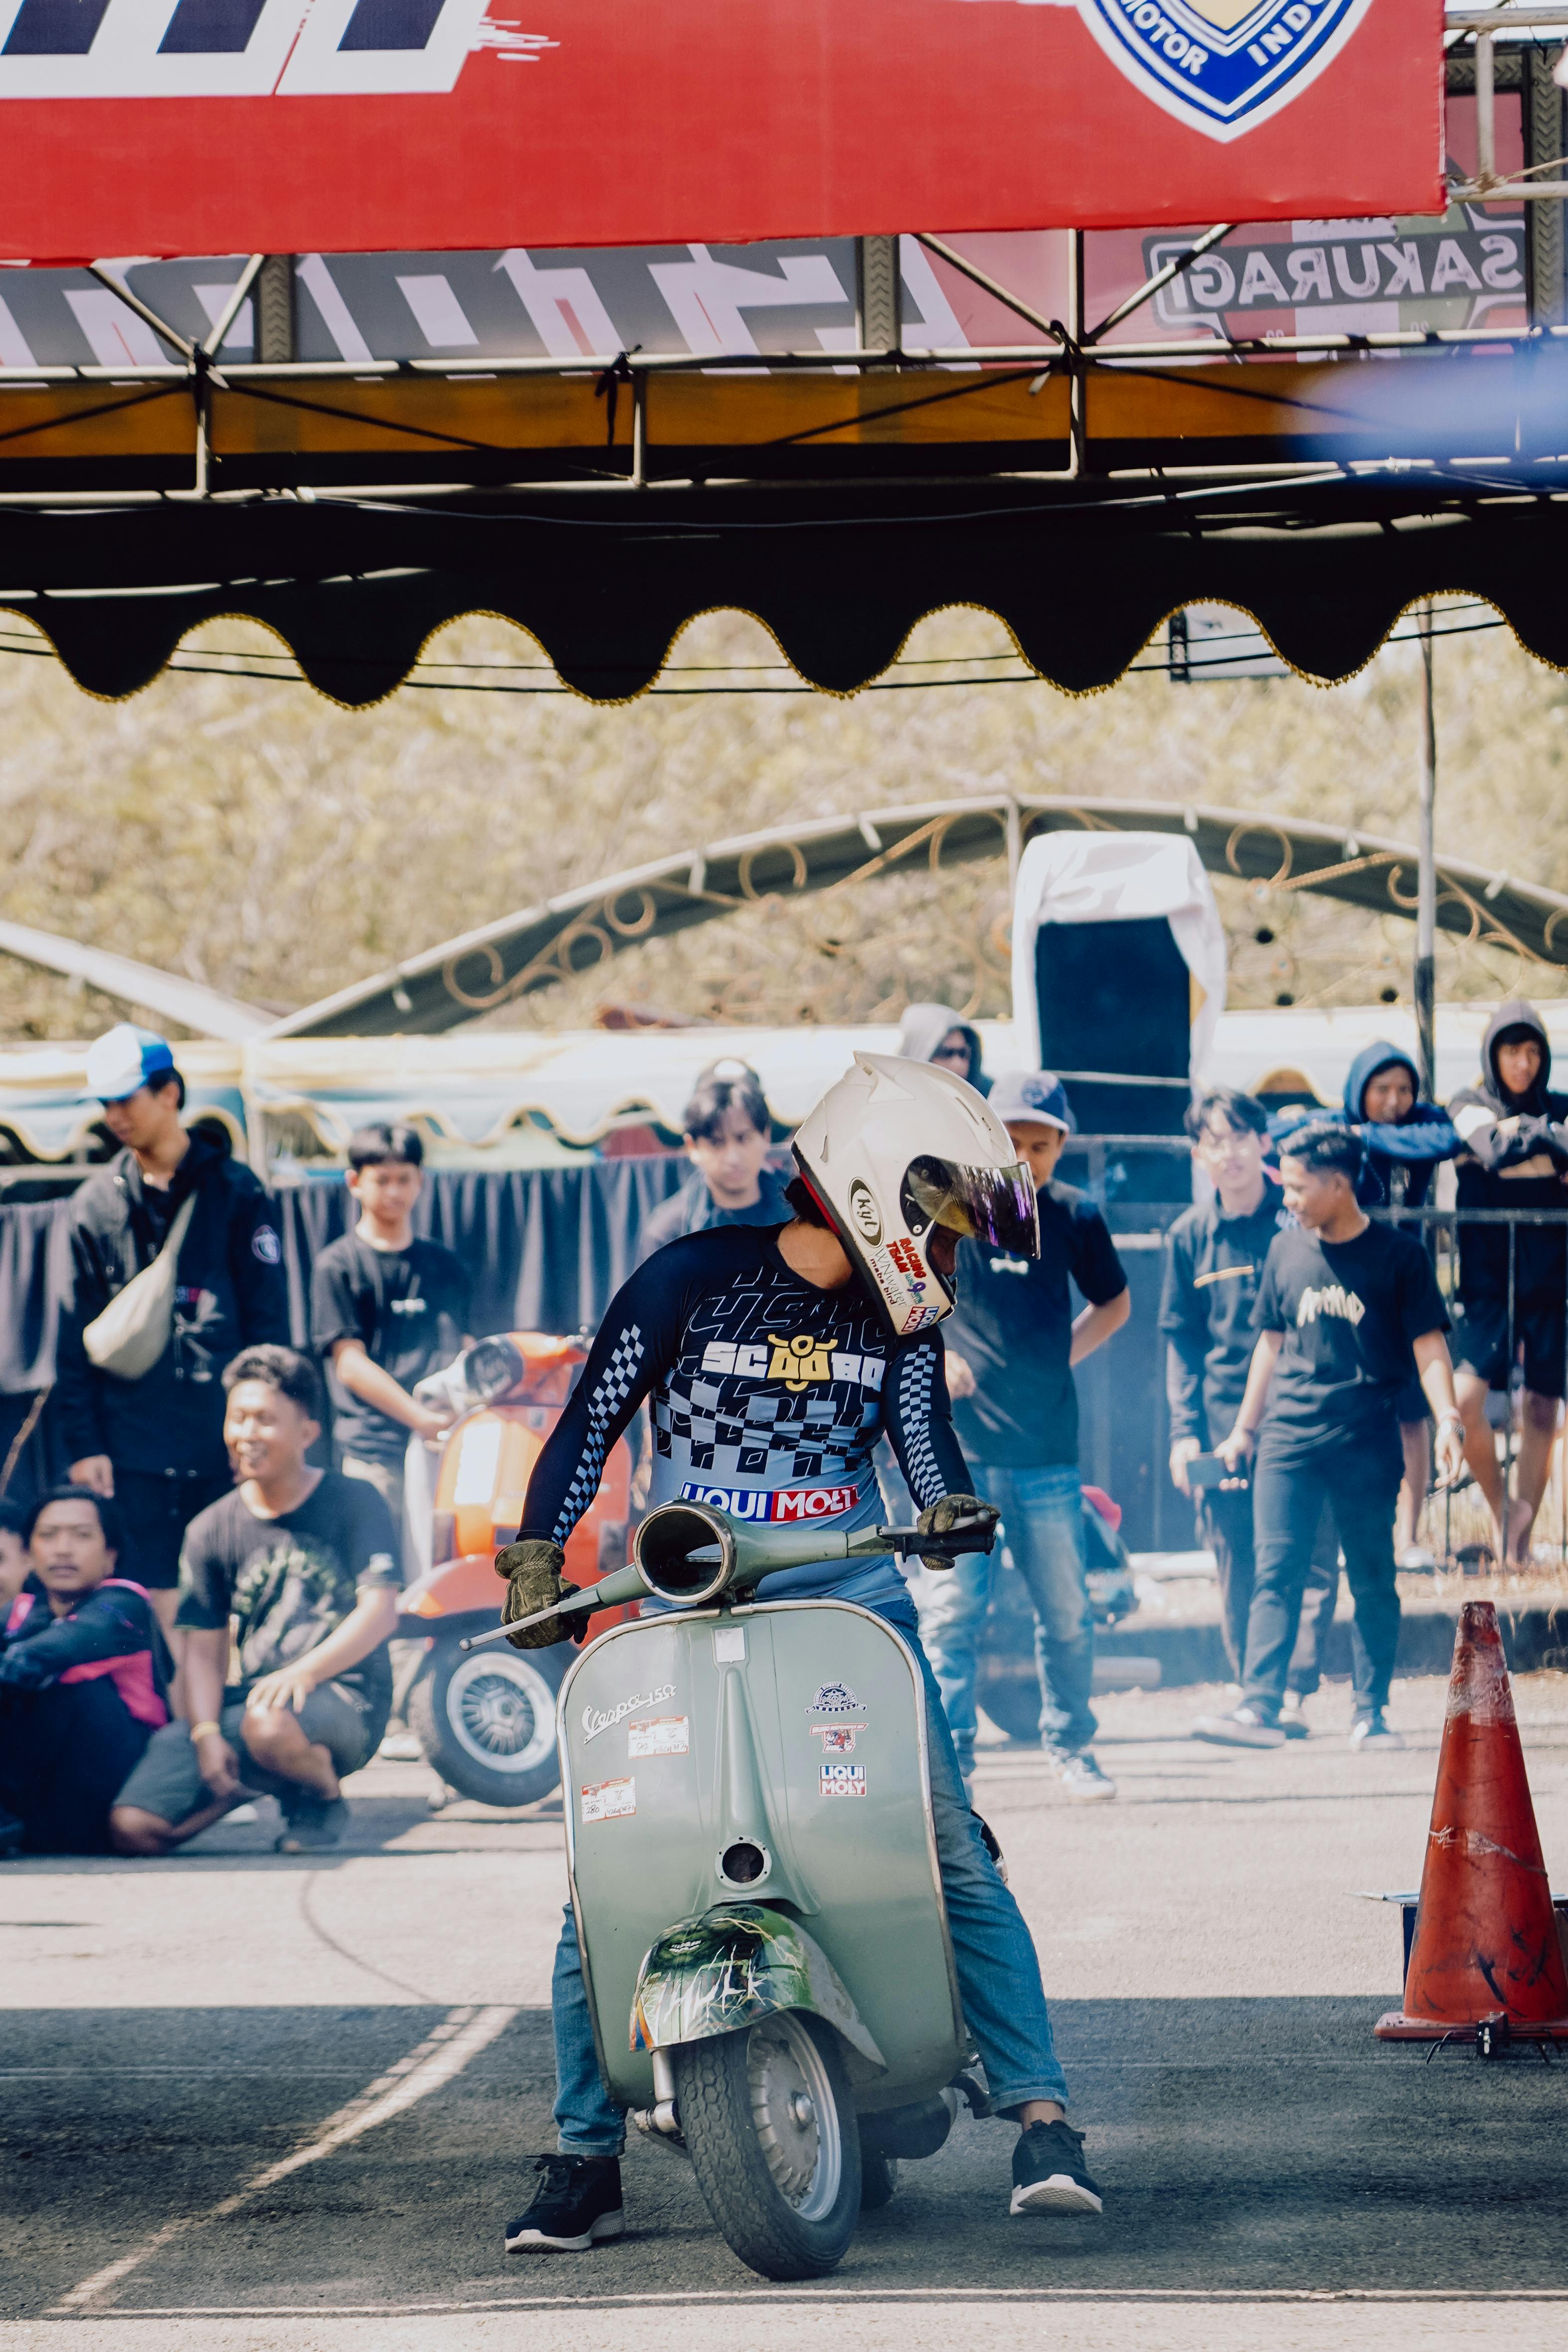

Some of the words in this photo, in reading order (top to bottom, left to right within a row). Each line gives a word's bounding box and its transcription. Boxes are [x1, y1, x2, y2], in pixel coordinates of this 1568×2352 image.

[1246, 0, 1325, 67] IND
[886, 1241, 910, 1273] TEAM
[915, 1307, 939, 1332] LIQU
[582, 1694, 643, 1744] Vespa
[646, 1684, 677, 1709] 150
[821, 1766, 864, 1780] LIQUI
[822, 1780, 865, 1794] MOLY
